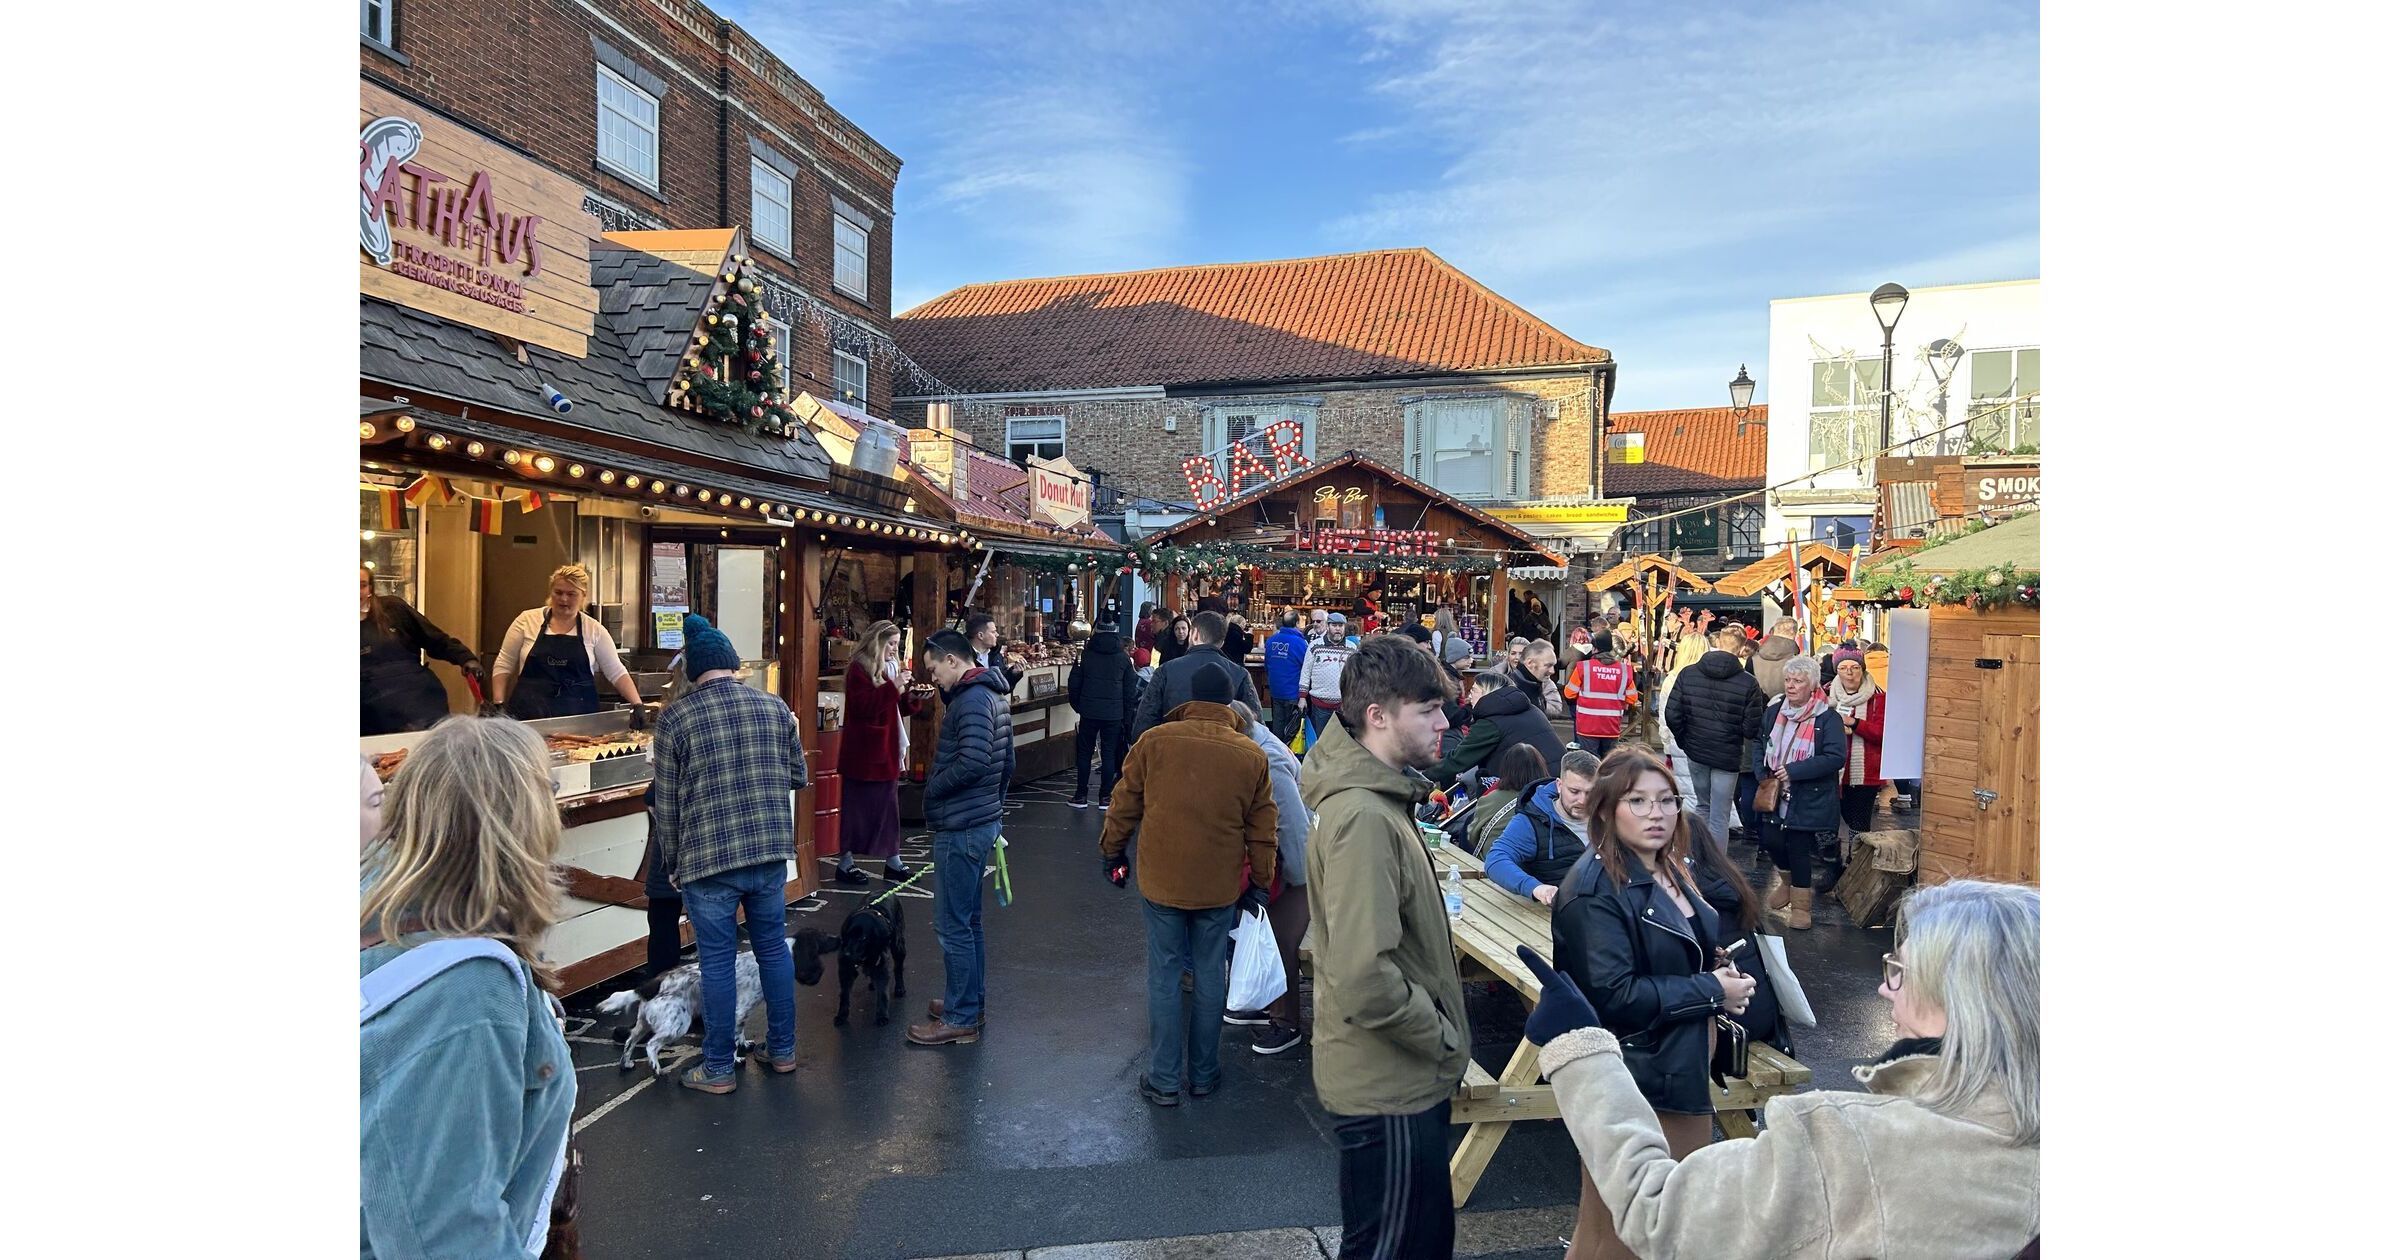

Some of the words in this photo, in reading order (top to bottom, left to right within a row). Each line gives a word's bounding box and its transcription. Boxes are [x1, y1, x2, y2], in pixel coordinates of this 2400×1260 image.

[398, 240, 528, 300] TRADITIONAL
[398, 262, 460, 292] GERMAN
[460, 282, 528, 315] SAUSAGES
[1183, 420, 1315, 511] BAR
[1040, 474, 1069, 505] Donut
[1313, 485, 1342, 503] Ski
[1343, 487, 1369, 505] Bar
[2017, 503, 2040, 511] POR
[1592, 666, 1621, 675] EVENTS
[1596, 672, 1617, 681] TEAM
